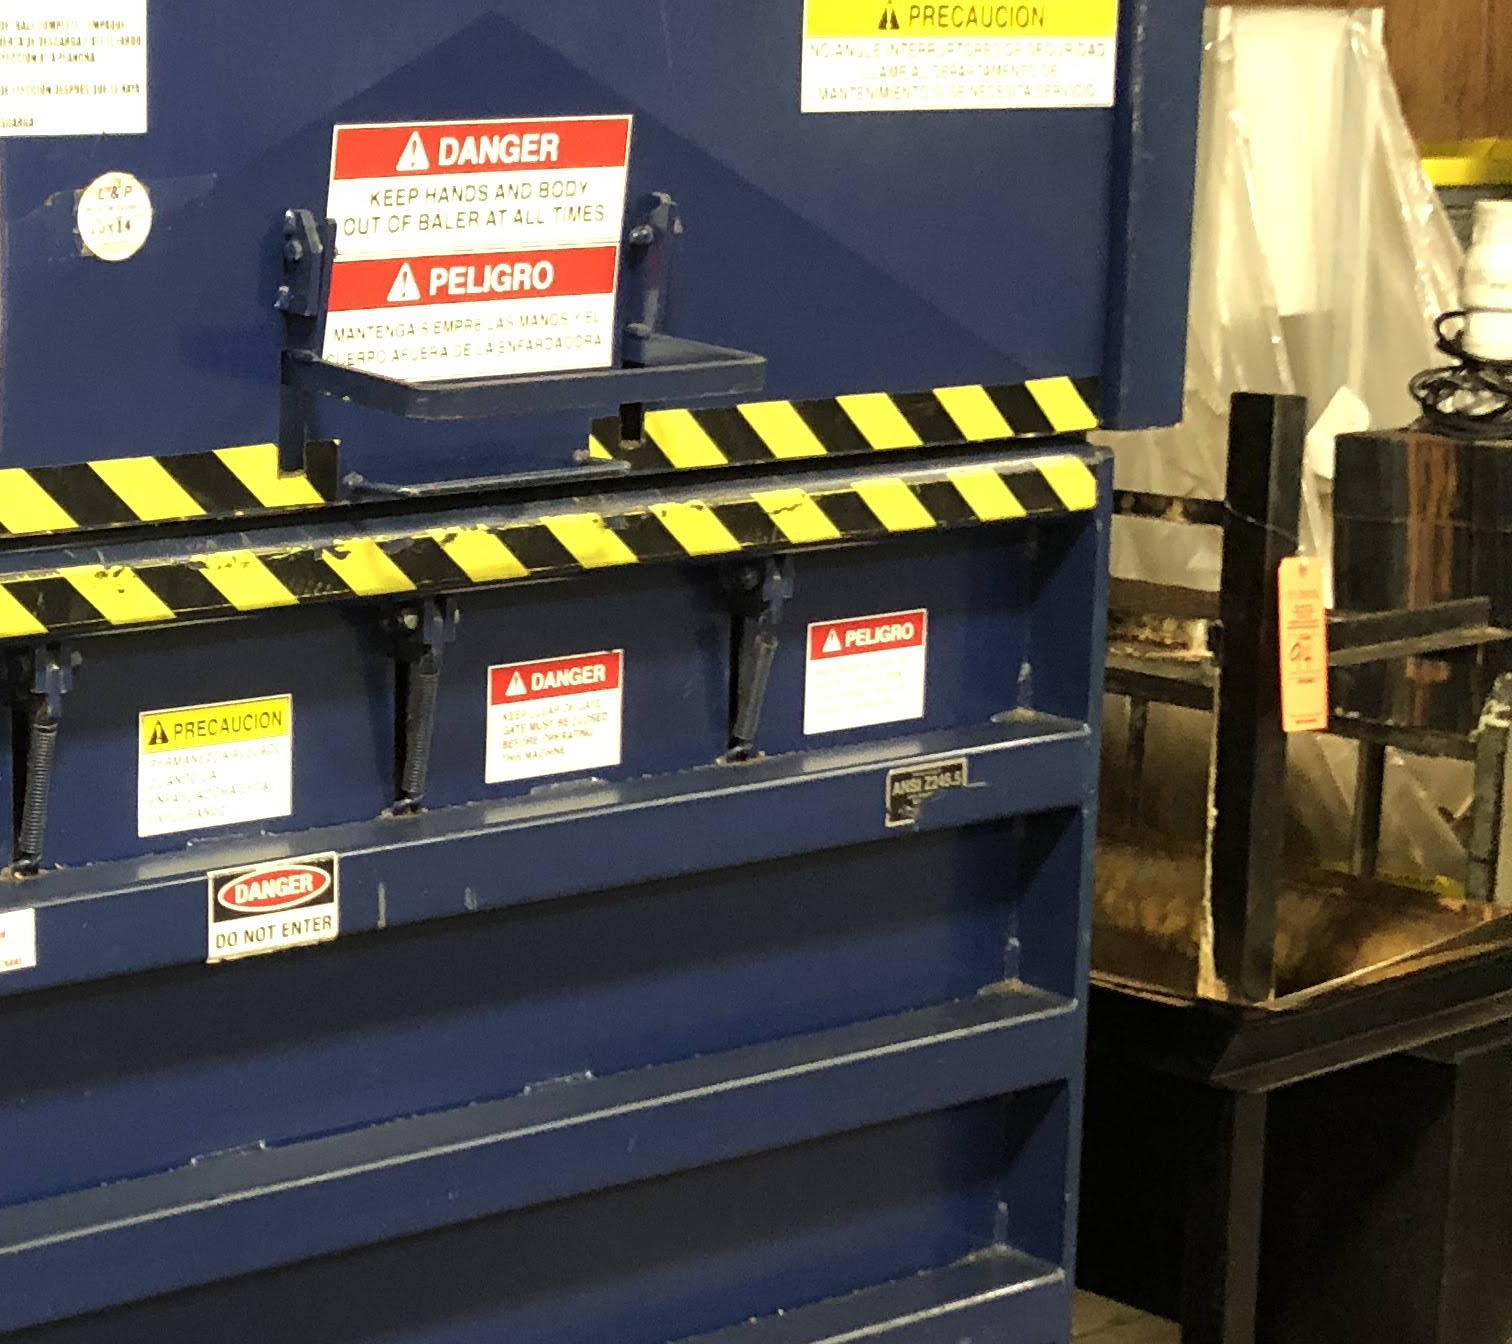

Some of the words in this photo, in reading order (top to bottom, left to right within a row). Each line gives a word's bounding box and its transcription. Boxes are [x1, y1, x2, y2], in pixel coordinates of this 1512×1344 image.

[908, 4, 1045, 28] PRECAUCION
[438, 133, 560, 166] DANGER
[110, 186, 119, 199] &
[124, 186, 132, 197] P
[370, 187, 419, 207] KEEP
[425, 185, 489, 203] HANDS
[495, 182, 532, 200] AND
[539, 180, 589, 198] BODY
[343, 216, 381, 236] OUT
[388, 215, 411, 233] OF
[419, 211, 480, 231] BALER
[485, 209, 508, 226] AT
[514, 207, 545, 225] ALL
[553, 204, 605, 224] TIMES
[429, 261, 554, 296] PELIGRO
[334, 323, 416, 343] MANTENGA
[420, 319, 481, 336] SIEMPRE
[519, 313, 569, 328] MANOS
[392, 344, 449, 363] AFUERA
[498, 334, 602, 354] ENFARDADORA
[845, 622, 915, 647] PELIGRO
[531, 664, 606, 691] DANGER
[174, 710, 282, 740] PRECAUCION
[892, 777, 922, 796] ANSI
[235, 873, 314, 903] DANGER
[216, 932, 237, 948] DO
[244, 925, 277, 945] NOT
[282, 915, 332, 937] ENTER
